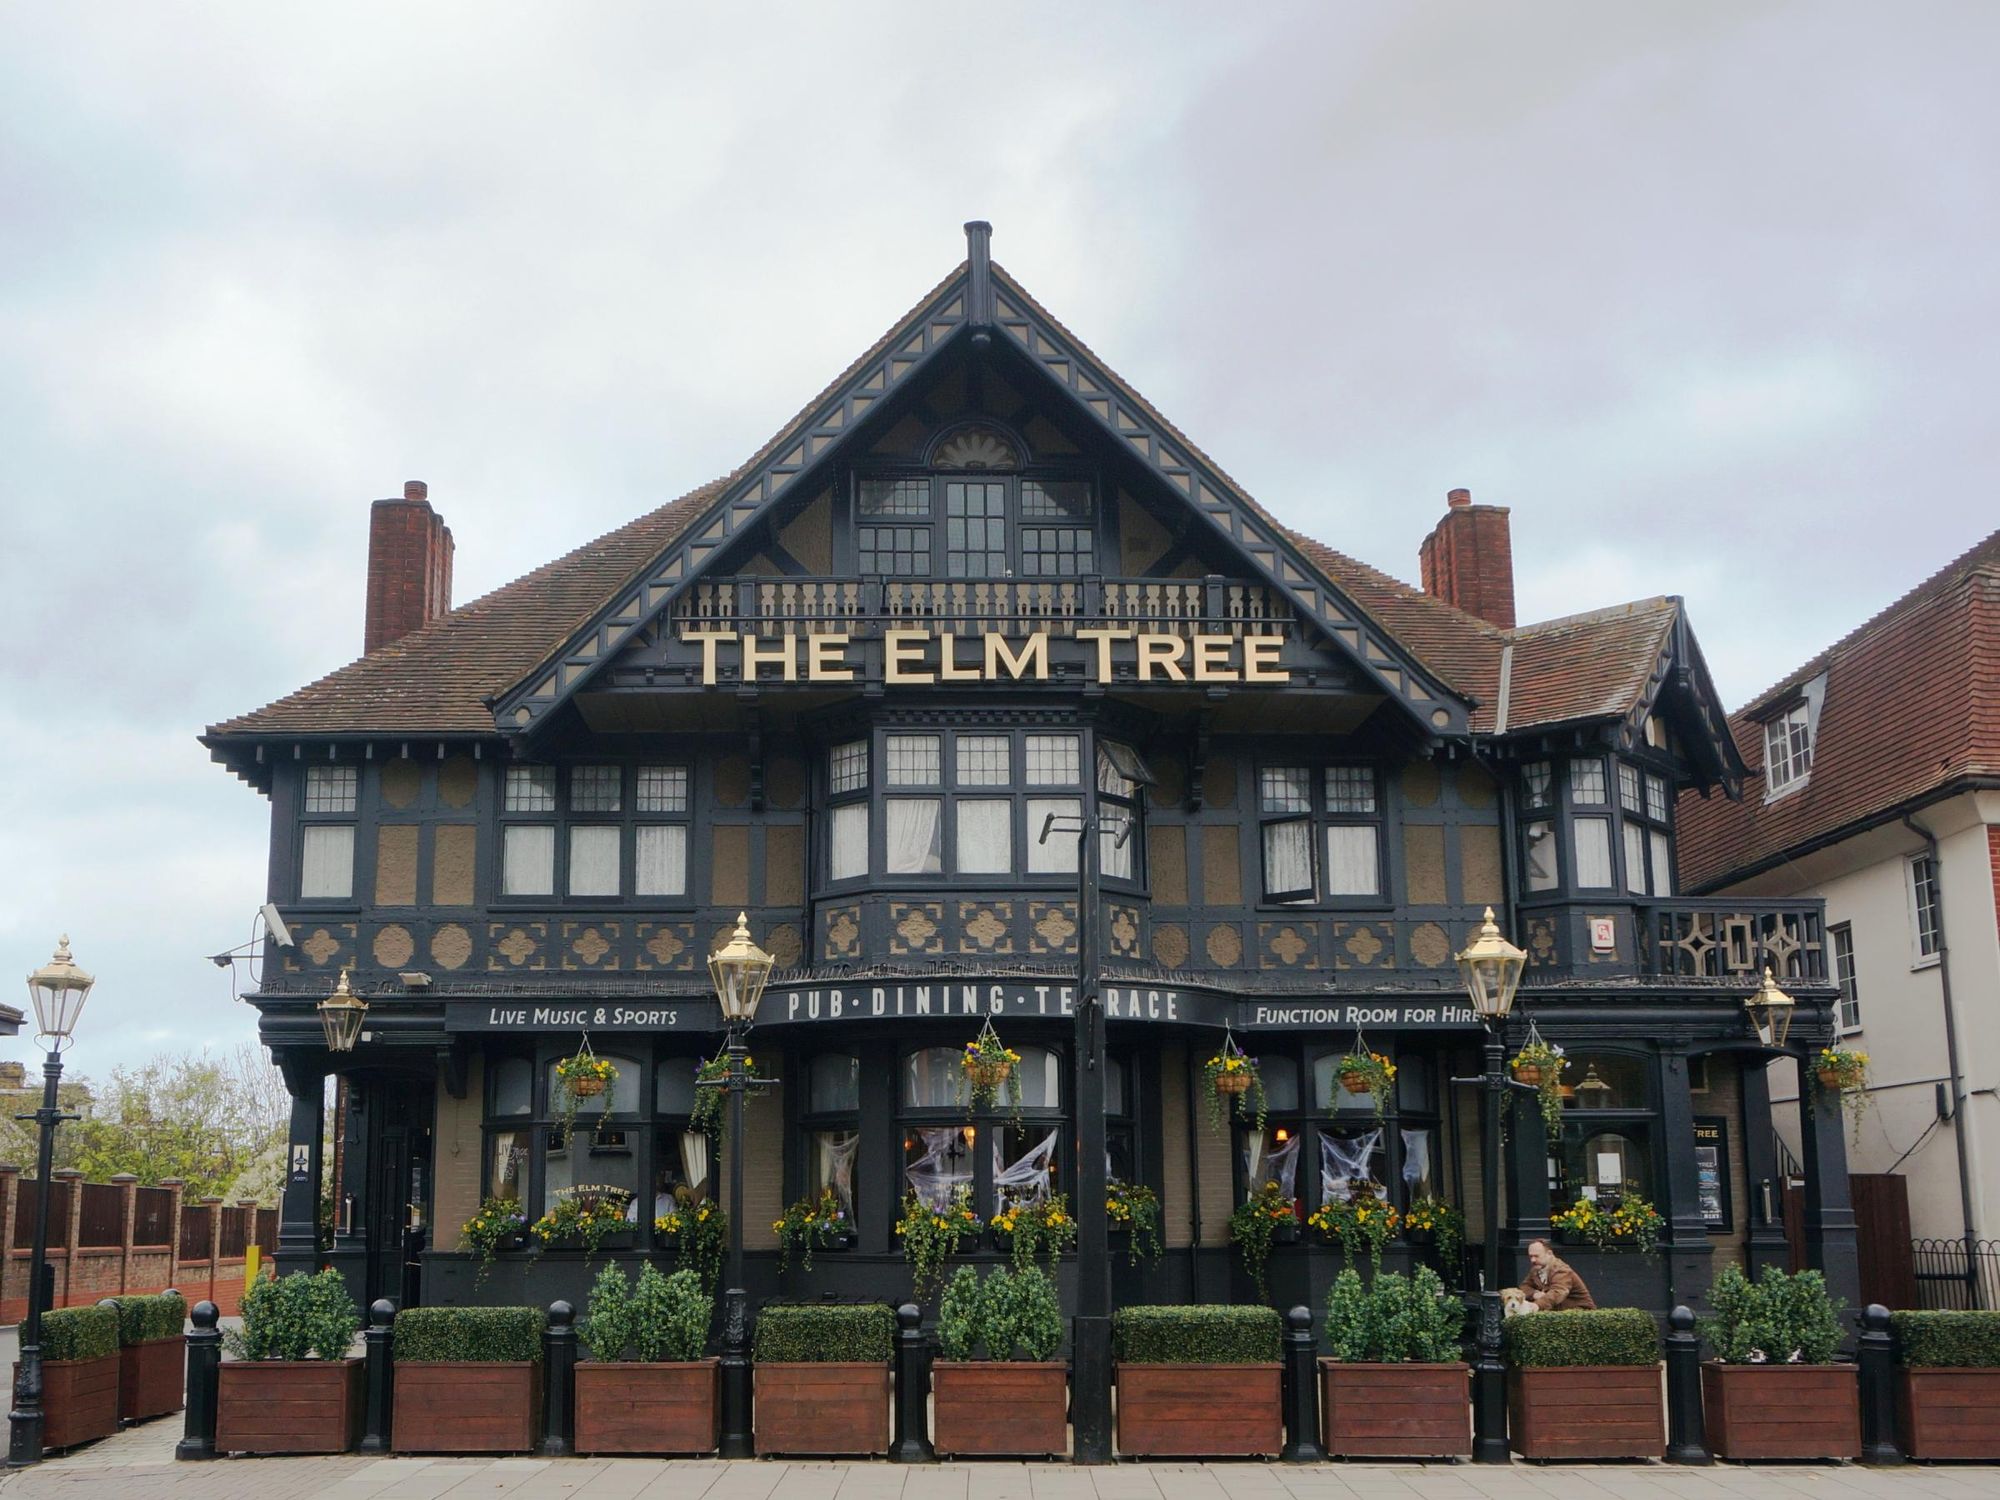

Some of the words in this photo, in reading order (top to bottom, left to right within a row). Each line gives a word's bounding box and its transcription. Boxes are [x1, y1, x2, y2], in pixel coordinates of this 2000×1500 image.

[682, 630, 854, 685] THE
[885, 629, 1049, 684] ELM
[1076, 629, 1290, 683] TREE
[788, 989, 843, 1021] PUB
[872, 985, 1004, 1016] DINING
[1034, 986, 1178, 1020] TERACE
[489, 1007, 527, 1025] LIVE
[532, 1007, 588, 1025] MUSIC
[593, 1007, 607, 1025] &
[612, 1007, 678, 1025] SPORTS
[1256, 1007, 1340, 1024] FUNCTION
[1345, 1006, 1398, 1023] ROOM
[1403, 1008, 1436, 1023] FOR
[553, 1186, 576, 1197] THE
[578, 1184, 601, 1192] ELM
[603, 1184, 631, 1197] TREE
